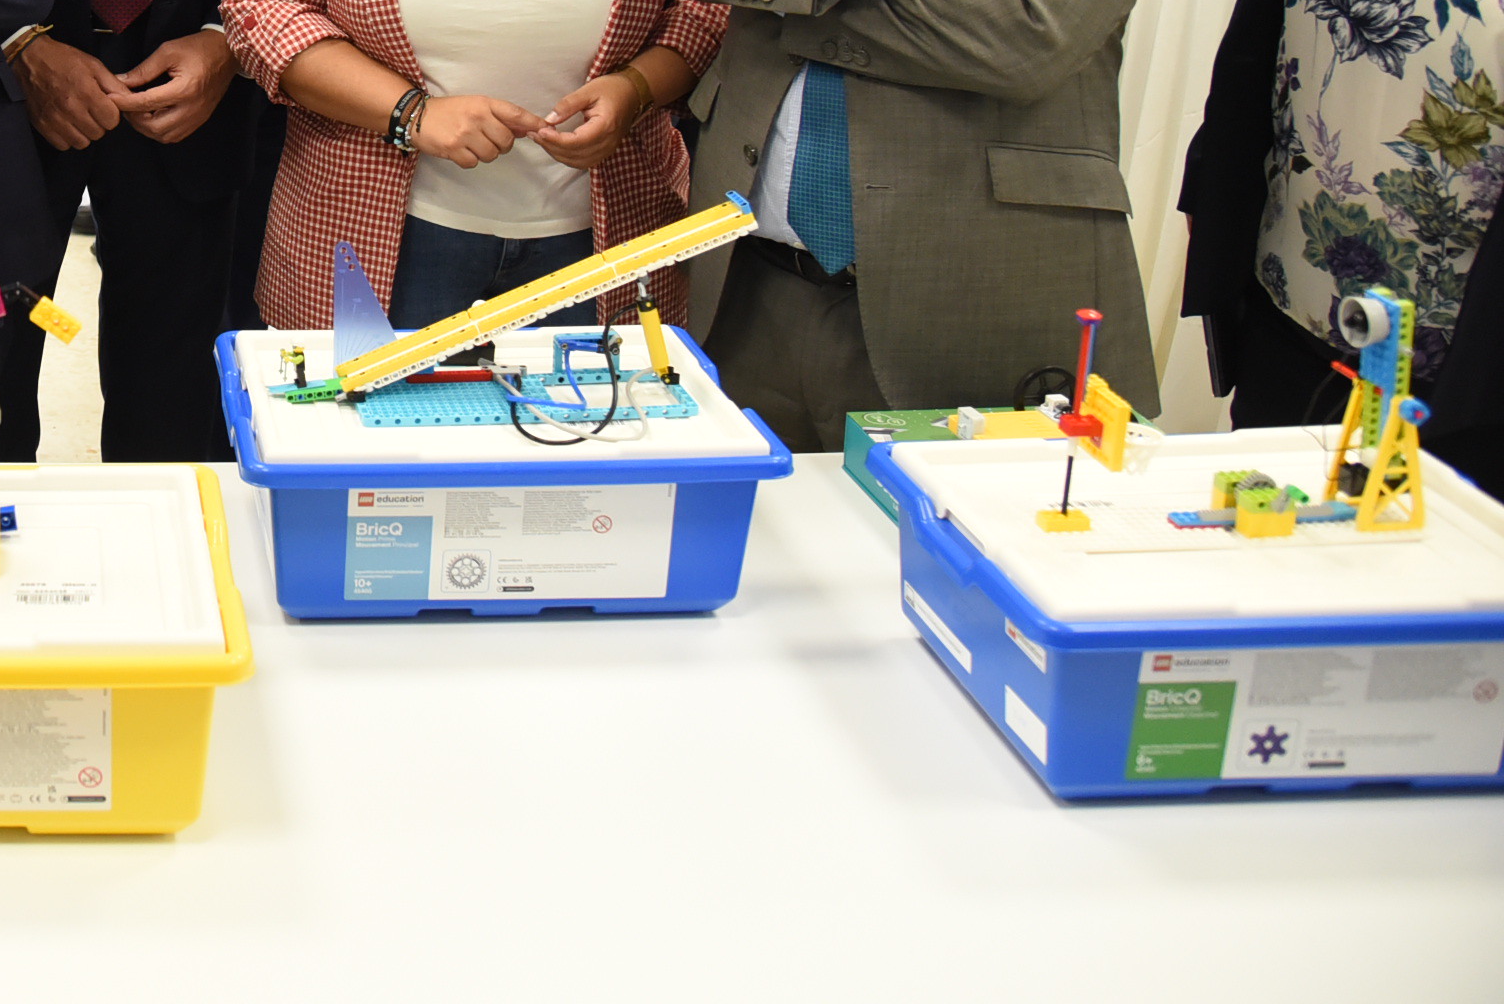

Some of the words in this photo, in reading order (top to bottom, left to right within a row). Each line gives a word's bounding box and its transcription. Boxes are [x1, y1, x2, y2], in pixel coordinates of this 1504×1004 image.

[376, 495, 425, 503] education
[356, 522, 403, 536] BricQ
[353, 578, 372, 588] 10+
[1145, 688, 1202, 706] BricQ
